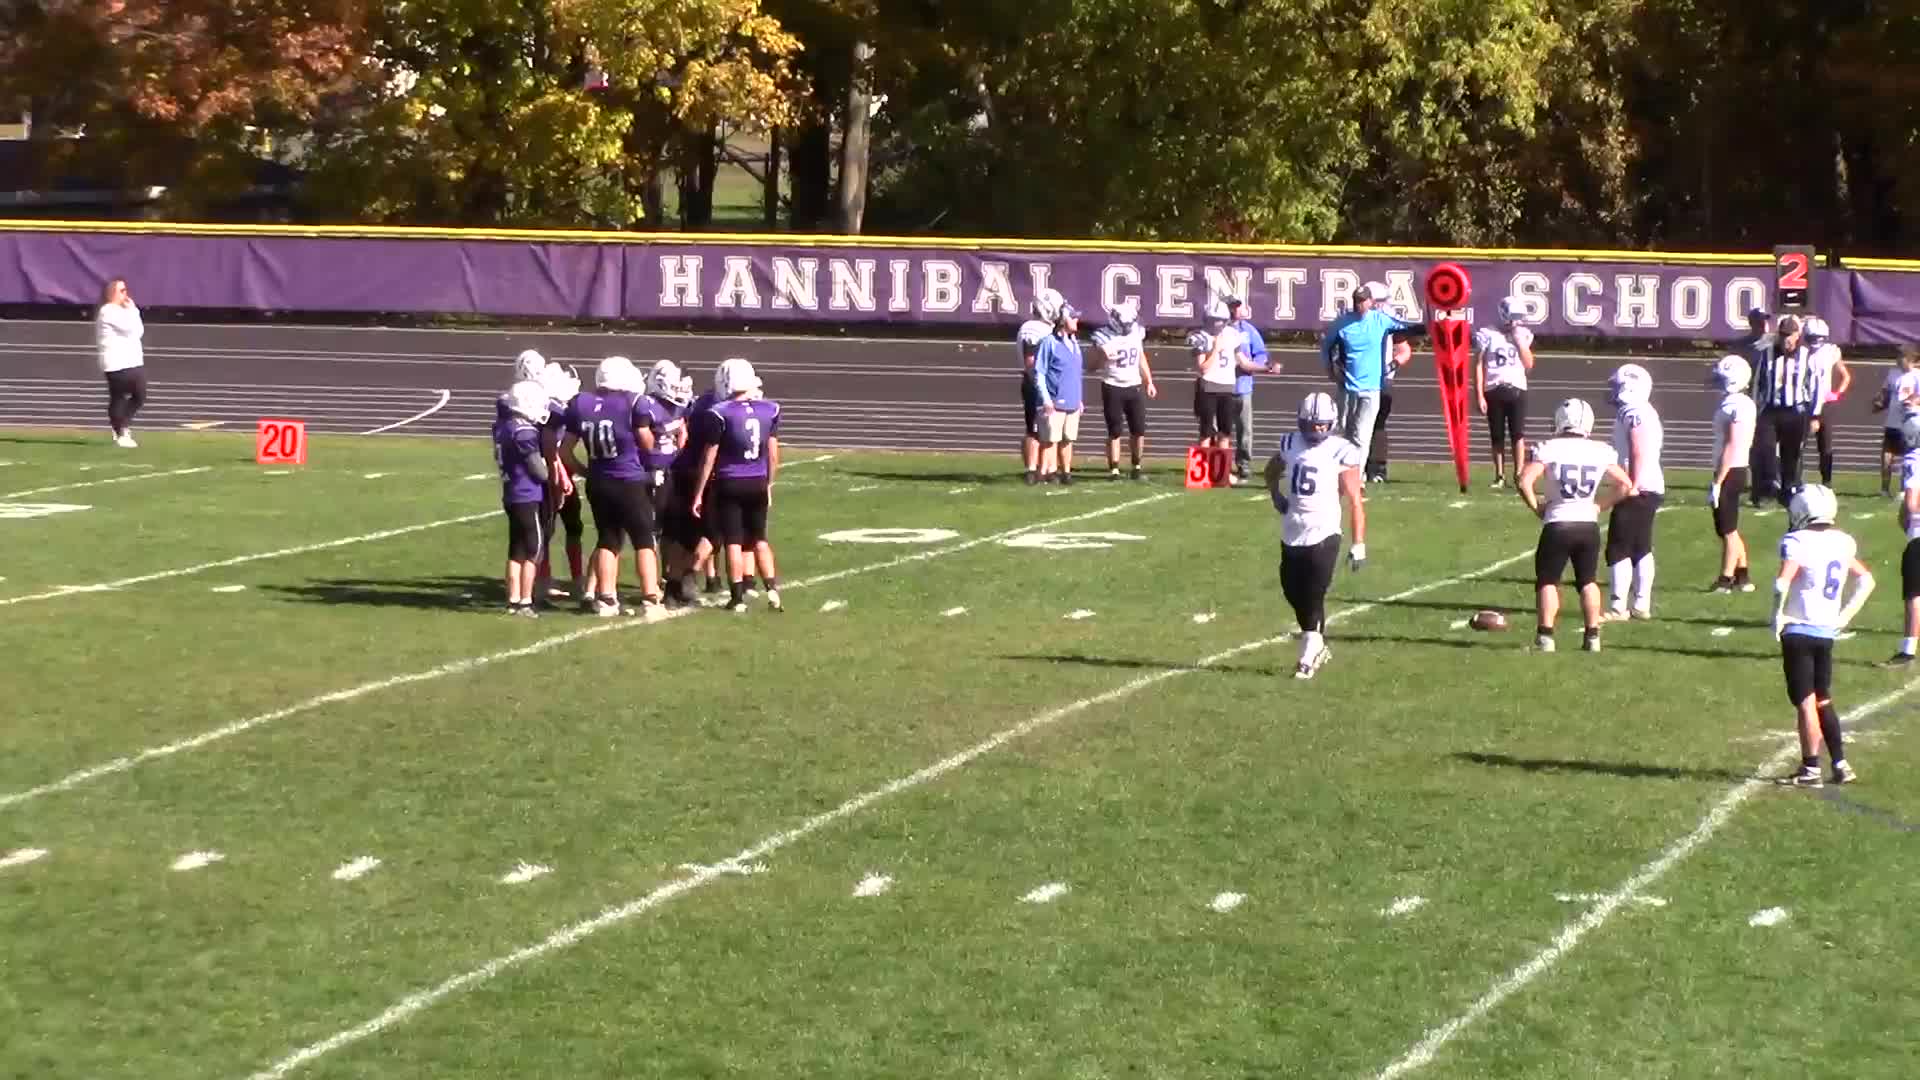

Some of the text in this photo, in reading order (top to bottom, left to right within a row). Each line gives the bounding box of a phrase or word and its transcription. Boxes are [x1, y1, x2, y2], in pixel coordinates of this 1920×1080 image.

[1779, 252, 1808, 289] 2
[1101, 264, 1473, 324] CENTRA
[1509, 272, 1767, 330] SCHOO
[1116, 348, 1137, 368] 28
[262, 423, 298, 458] 20
[744, 418, 760, 460] 3
[1190, 450, 1226, 482] 30
[1560, 464, 1598, 499] 55
